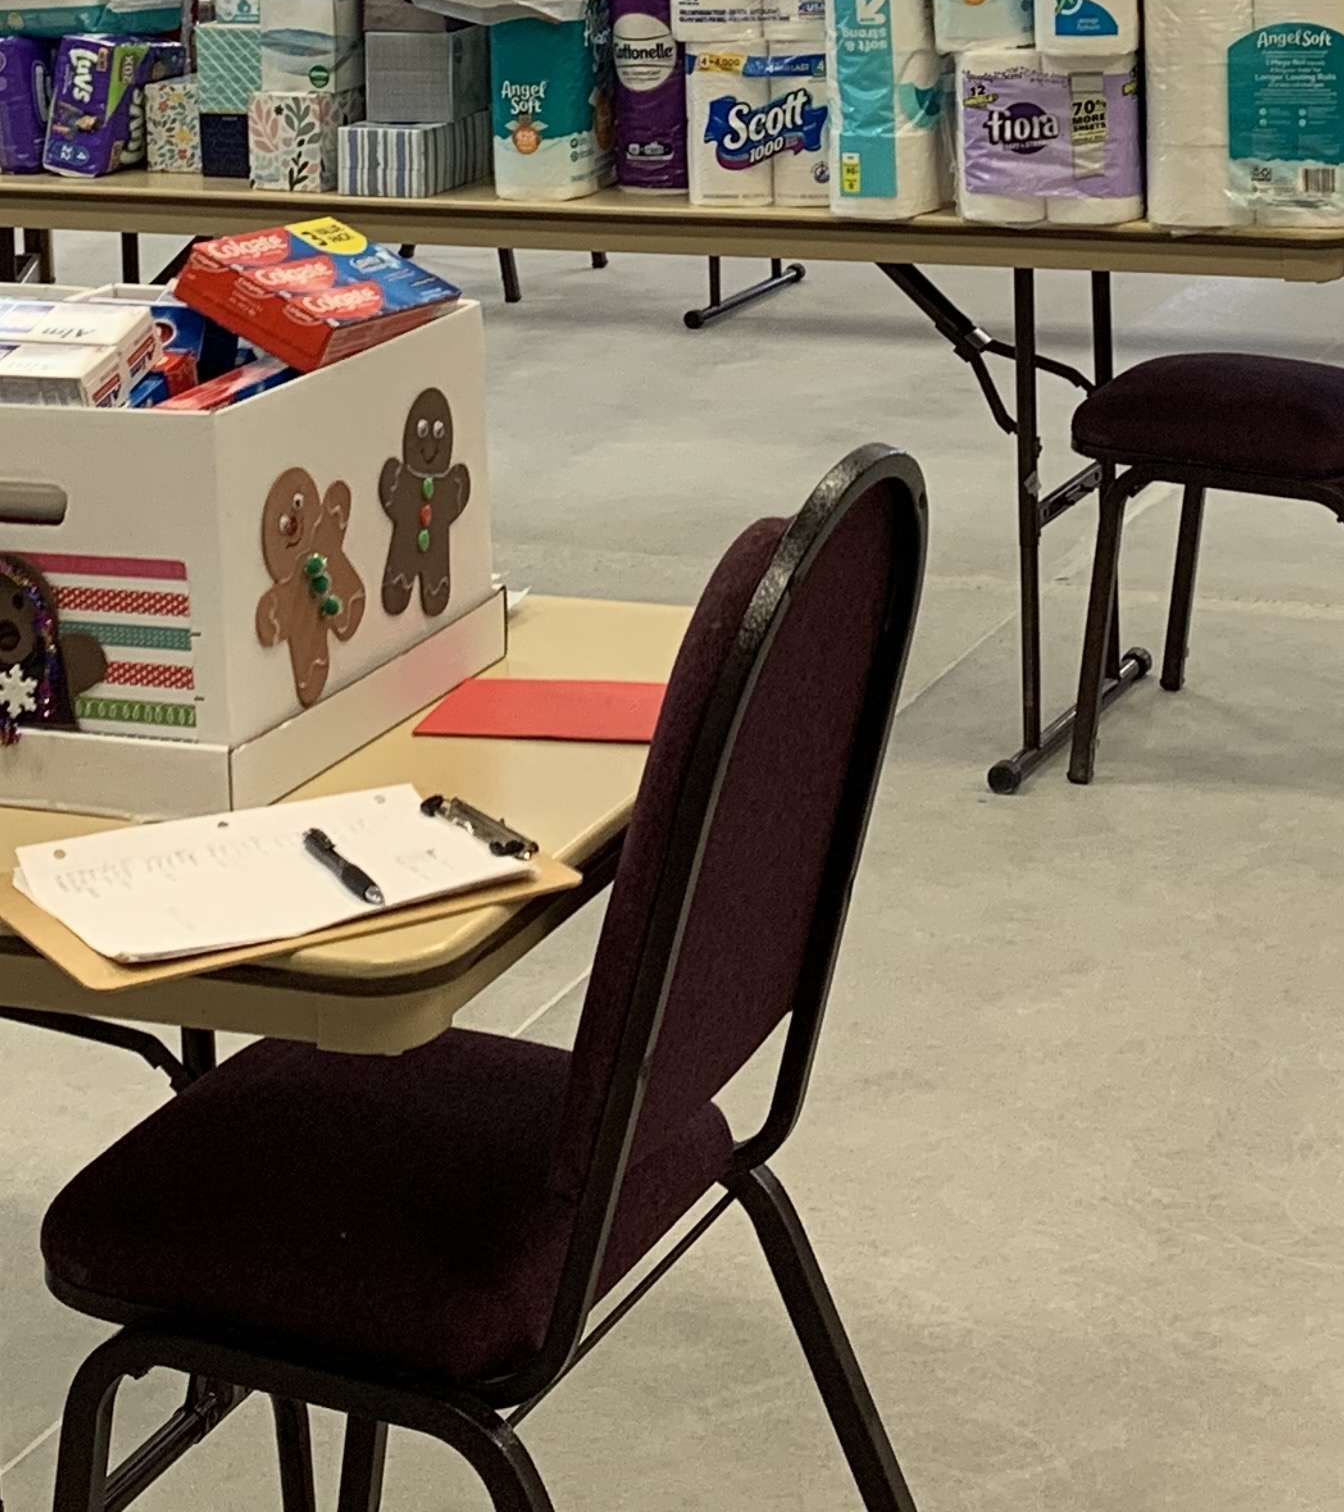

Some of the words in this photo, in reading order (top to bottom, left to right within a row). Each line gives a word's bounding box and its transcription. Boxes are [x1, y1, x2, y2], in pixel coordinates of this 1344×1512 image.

[841, 27, 888, 40] strong
[859, 39, 888, 52] soft
[1256, 30, 1303, 48] Angel
[1303, 31, 1333, 48] Soft
[69, 48, 99, 104] Luvs
[501, 80, 548, 99] Angel
[510, 96, 543, 115] Soft
[722, 89, 808, 151] Scott
[985, 109, 1060, 145] fiora
[748, 137, 785, 164] 1000
[207, 233, 289, 260] Colgate
[254, 260, 335, 286] Colgate
[301, 286, 380, 314] Colgate
